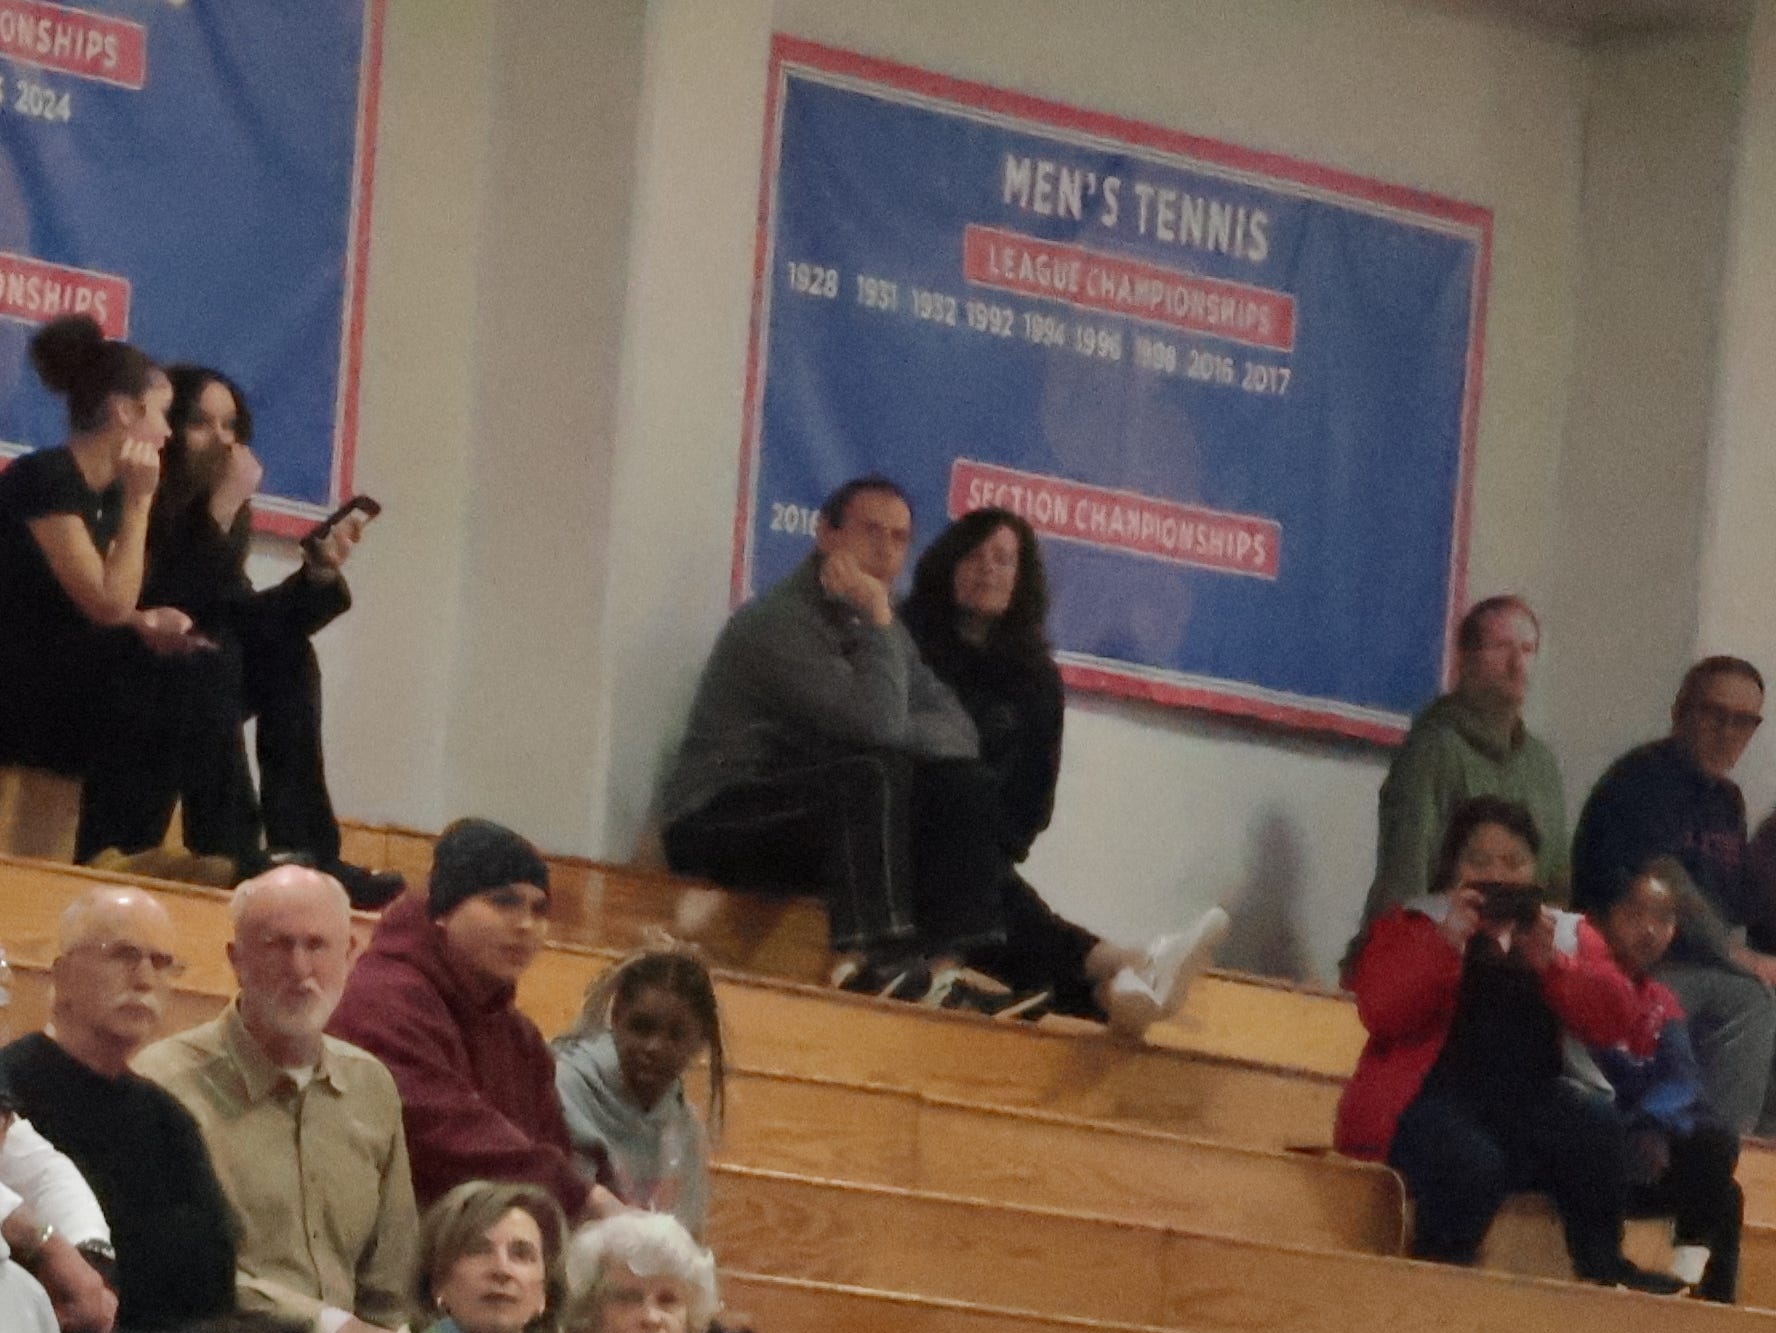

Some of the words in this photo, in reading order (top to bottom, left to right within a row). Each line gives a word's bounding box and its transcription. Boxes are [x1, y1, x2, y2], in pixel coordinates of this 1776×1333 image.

[15, 79, 72, 122] 2024
[1003, 154, 1122, 228] MEN'S
[1135, 183, 1270, 263] TENNIS
[787, 260, 839, 299] 1928
[989, 243, 1079, 293] LEAGUE
[1087, 267, 1271, 335] CHAMPIONSHIPS
[969, 477, 1069, 525] SECTION
[1074, 499, 1267, 566] CHAMPIONSHIPS
